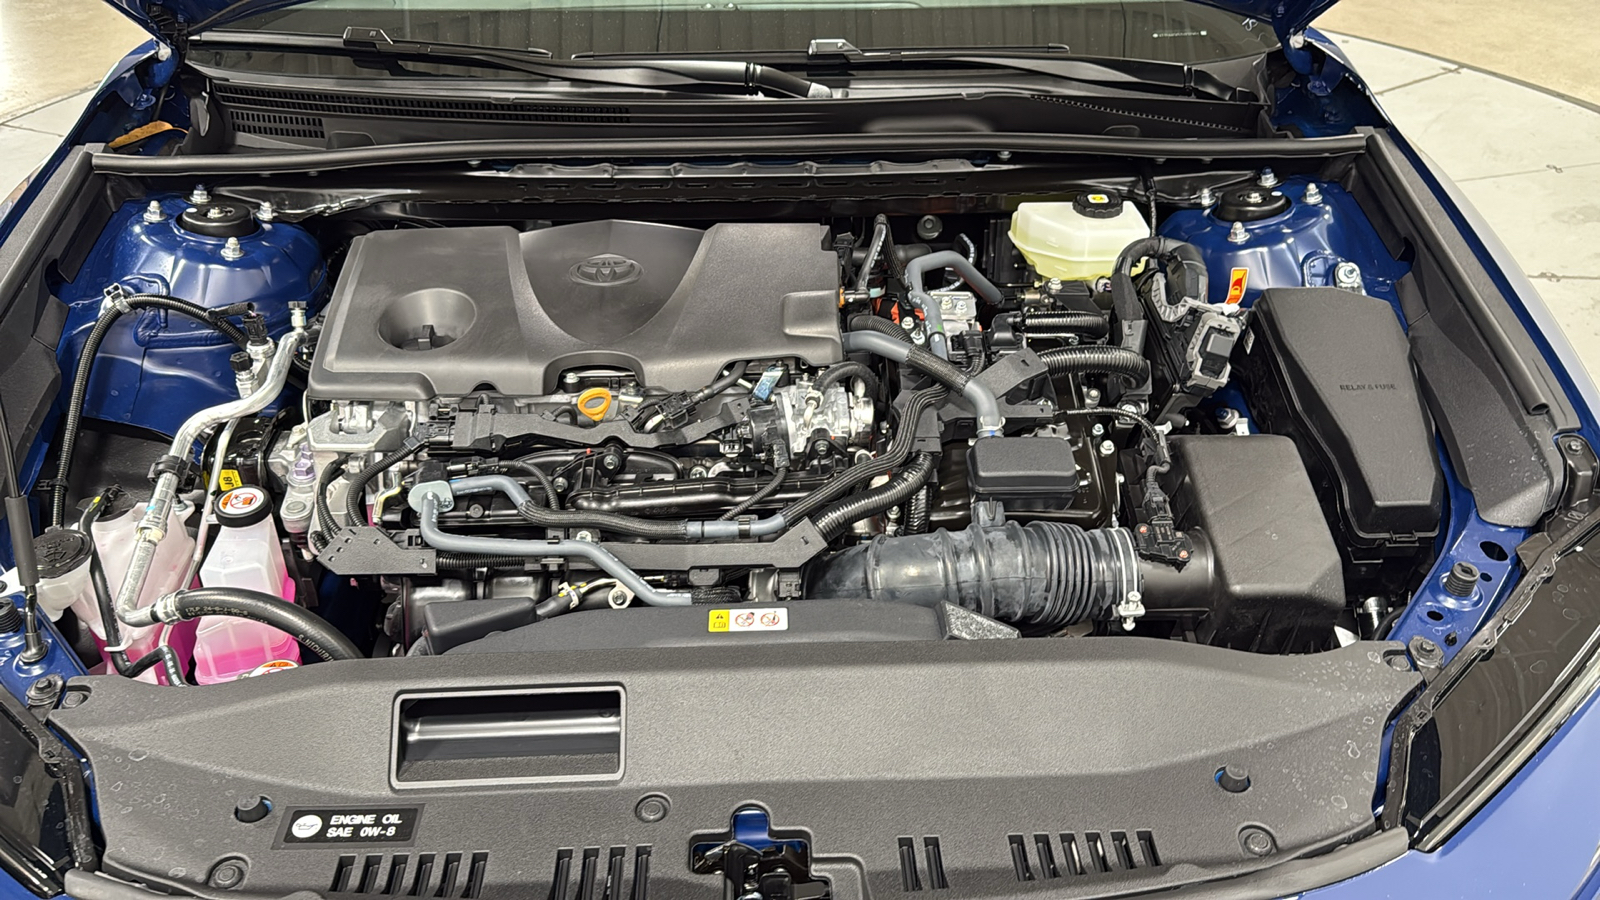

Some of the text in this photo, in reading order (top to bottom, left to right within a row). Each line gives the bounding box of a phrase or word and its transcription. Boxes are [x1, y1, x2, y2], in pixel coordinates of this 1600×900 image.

[329, 814, 403, 825] ENGINE OIL
[326, 826, 397, 838] SAE 0W-8
